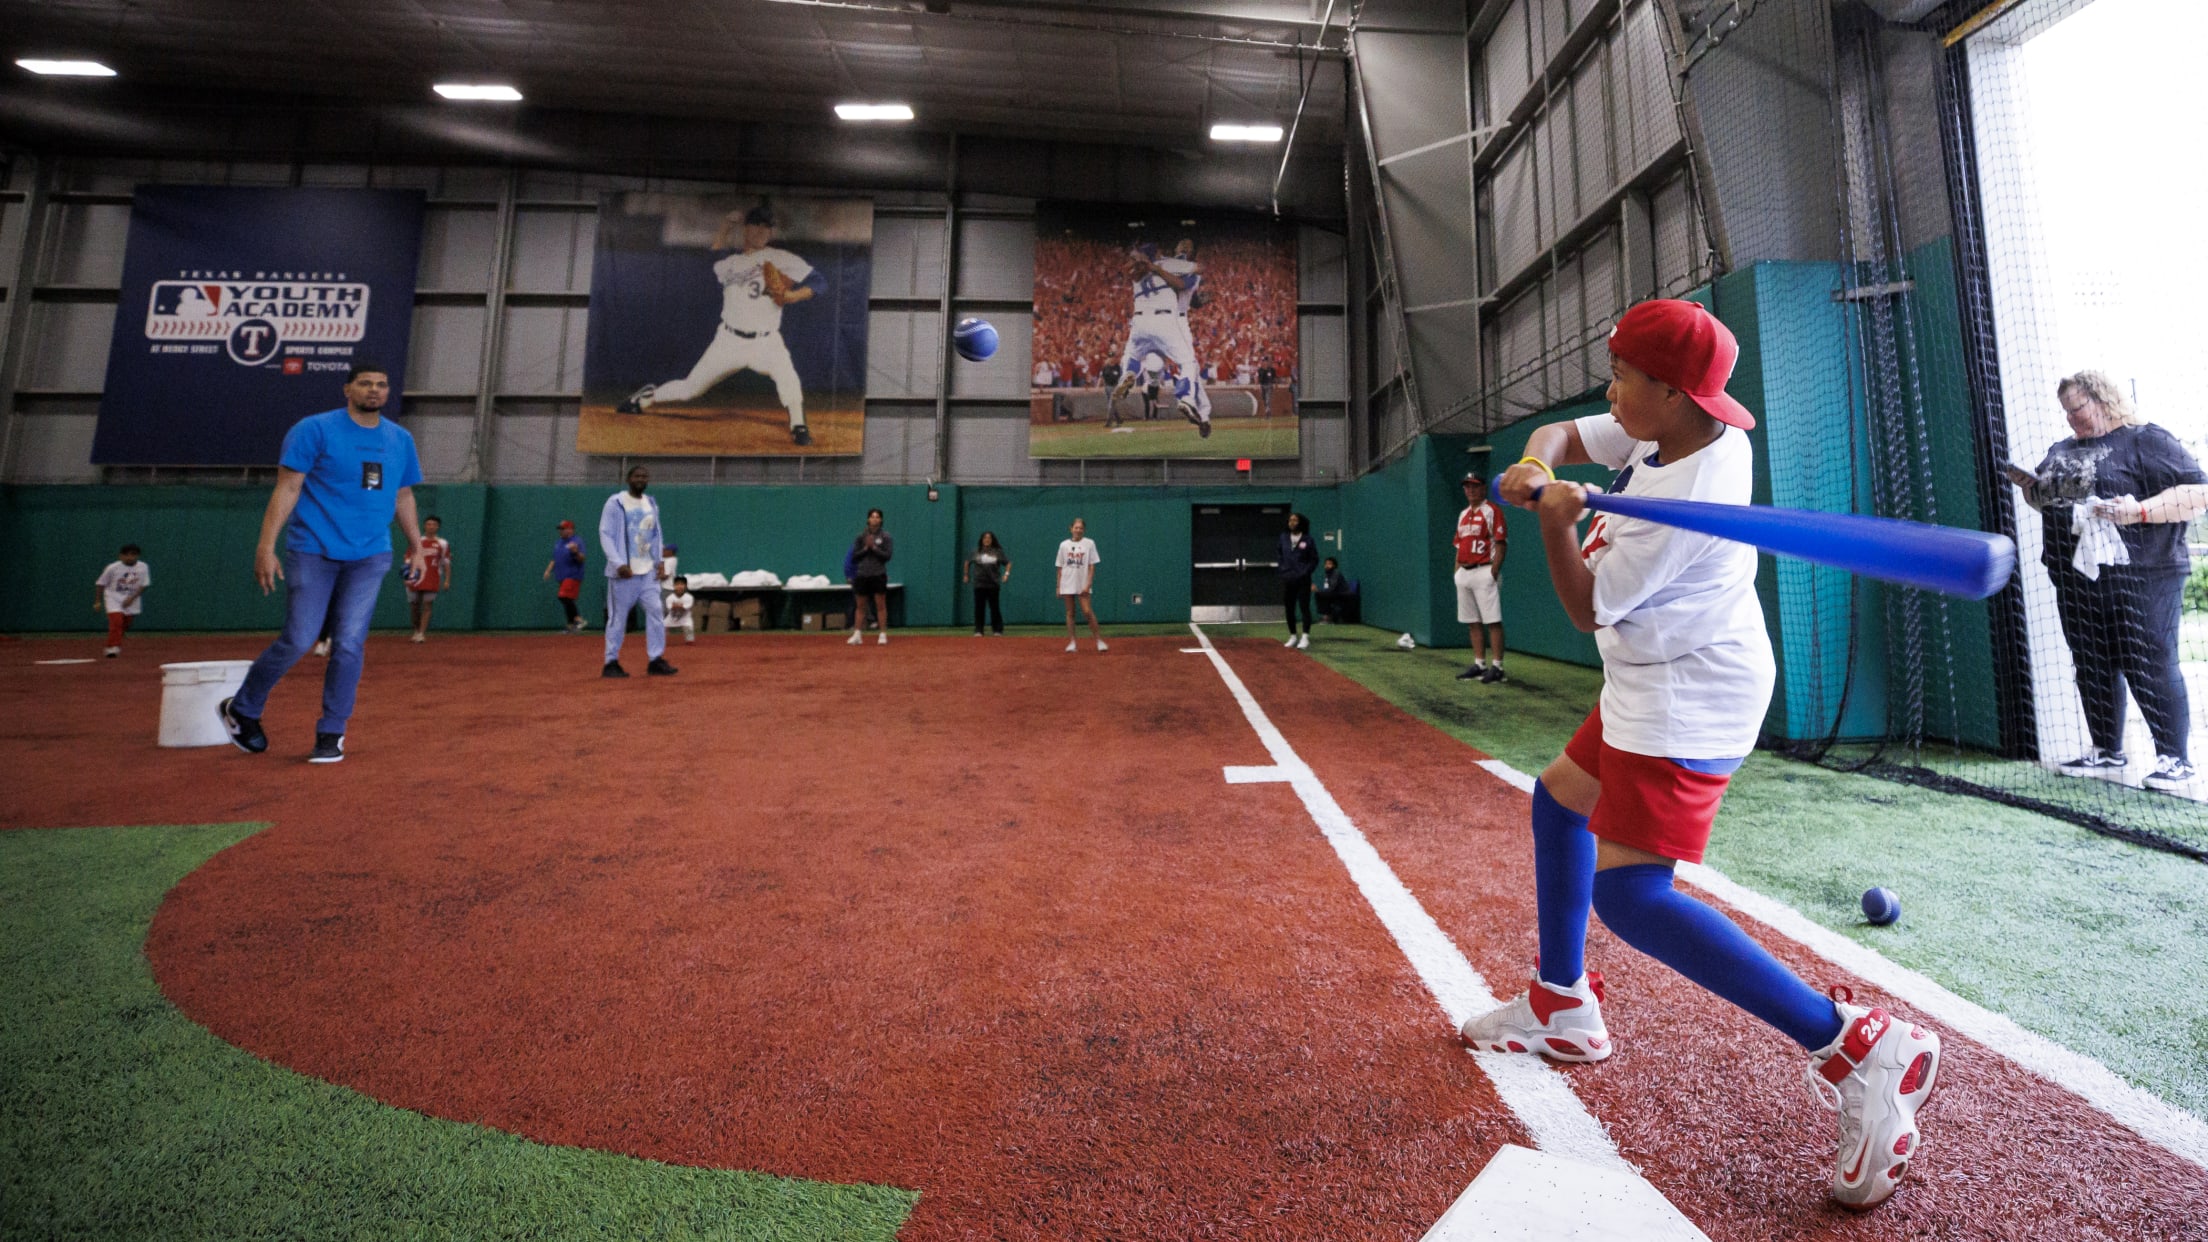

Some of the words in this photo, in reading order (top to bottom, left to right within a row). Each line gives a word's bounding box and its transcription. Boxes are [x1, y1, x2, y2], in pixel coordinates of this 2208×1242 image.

[180, 271, 242, 279] TEXAS
[256, 272, 346, 280] RANGERS
[225, 286, 362, 301] YOUTH
[748, 281, 766, 299] 3
[223, 302, 360, 318] ACADEMY
[240, 326, 269, 356] T
[190, 345, 218, 354] STREET
[285, 346, 315, 355] SPORTS
[317, 346, 353, 356] COMPLEX
[307, 361, 351, 371] TOYOTA
[1471, 539, 1485, 554] 12
[1860, 1017, 1884, 1042] 24
